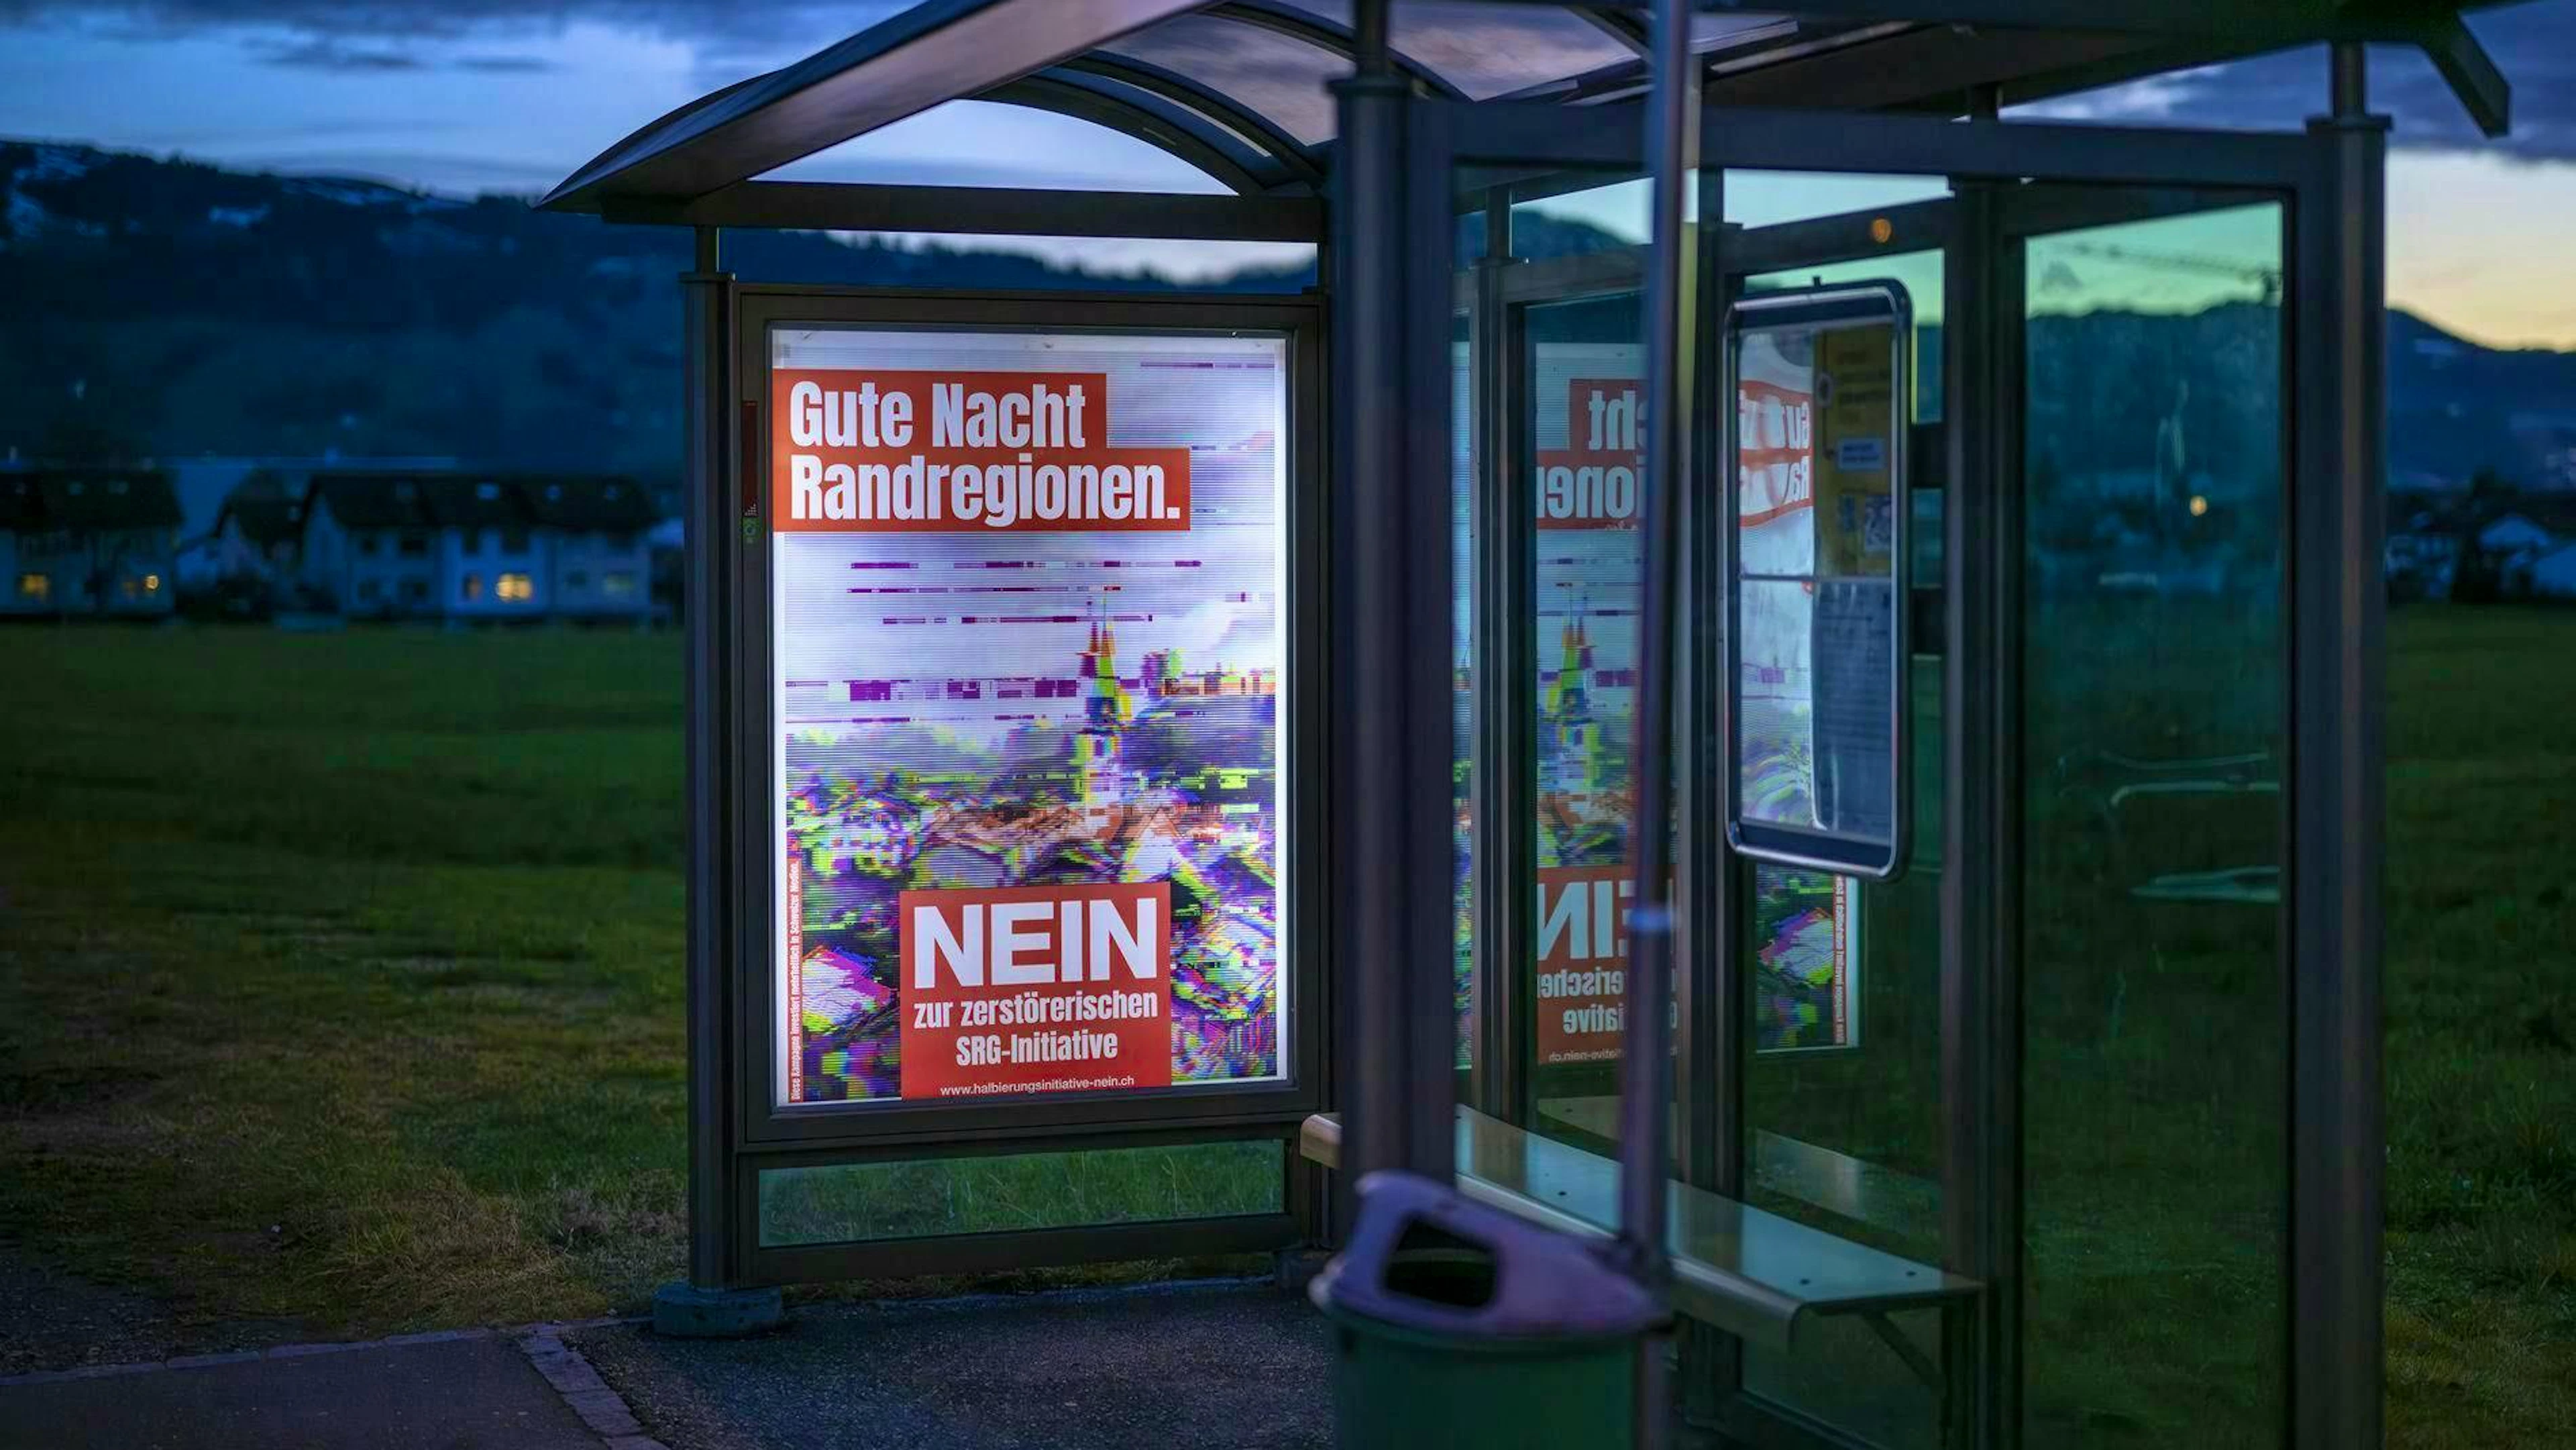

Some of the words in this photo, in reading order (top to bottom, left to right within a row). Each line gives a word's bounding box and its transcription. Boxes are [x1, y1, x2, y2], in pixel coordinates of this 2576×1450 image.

[790, 380, 913, 448] Gute
[932, 383, 1085, 448] Nacht
[790, 454, 1181, 527] Randregionen.
[914, 897, 1157, 989] NEIN
[914, 1001, 953, 1029] zur
[961, 989, 1158, 1027] zerstörerischen
[956, 1029, 1118, 1066] SRG-Initiative
[940, 1076, 1134, 1096] www.halbierungsinitiative-nein.ch
